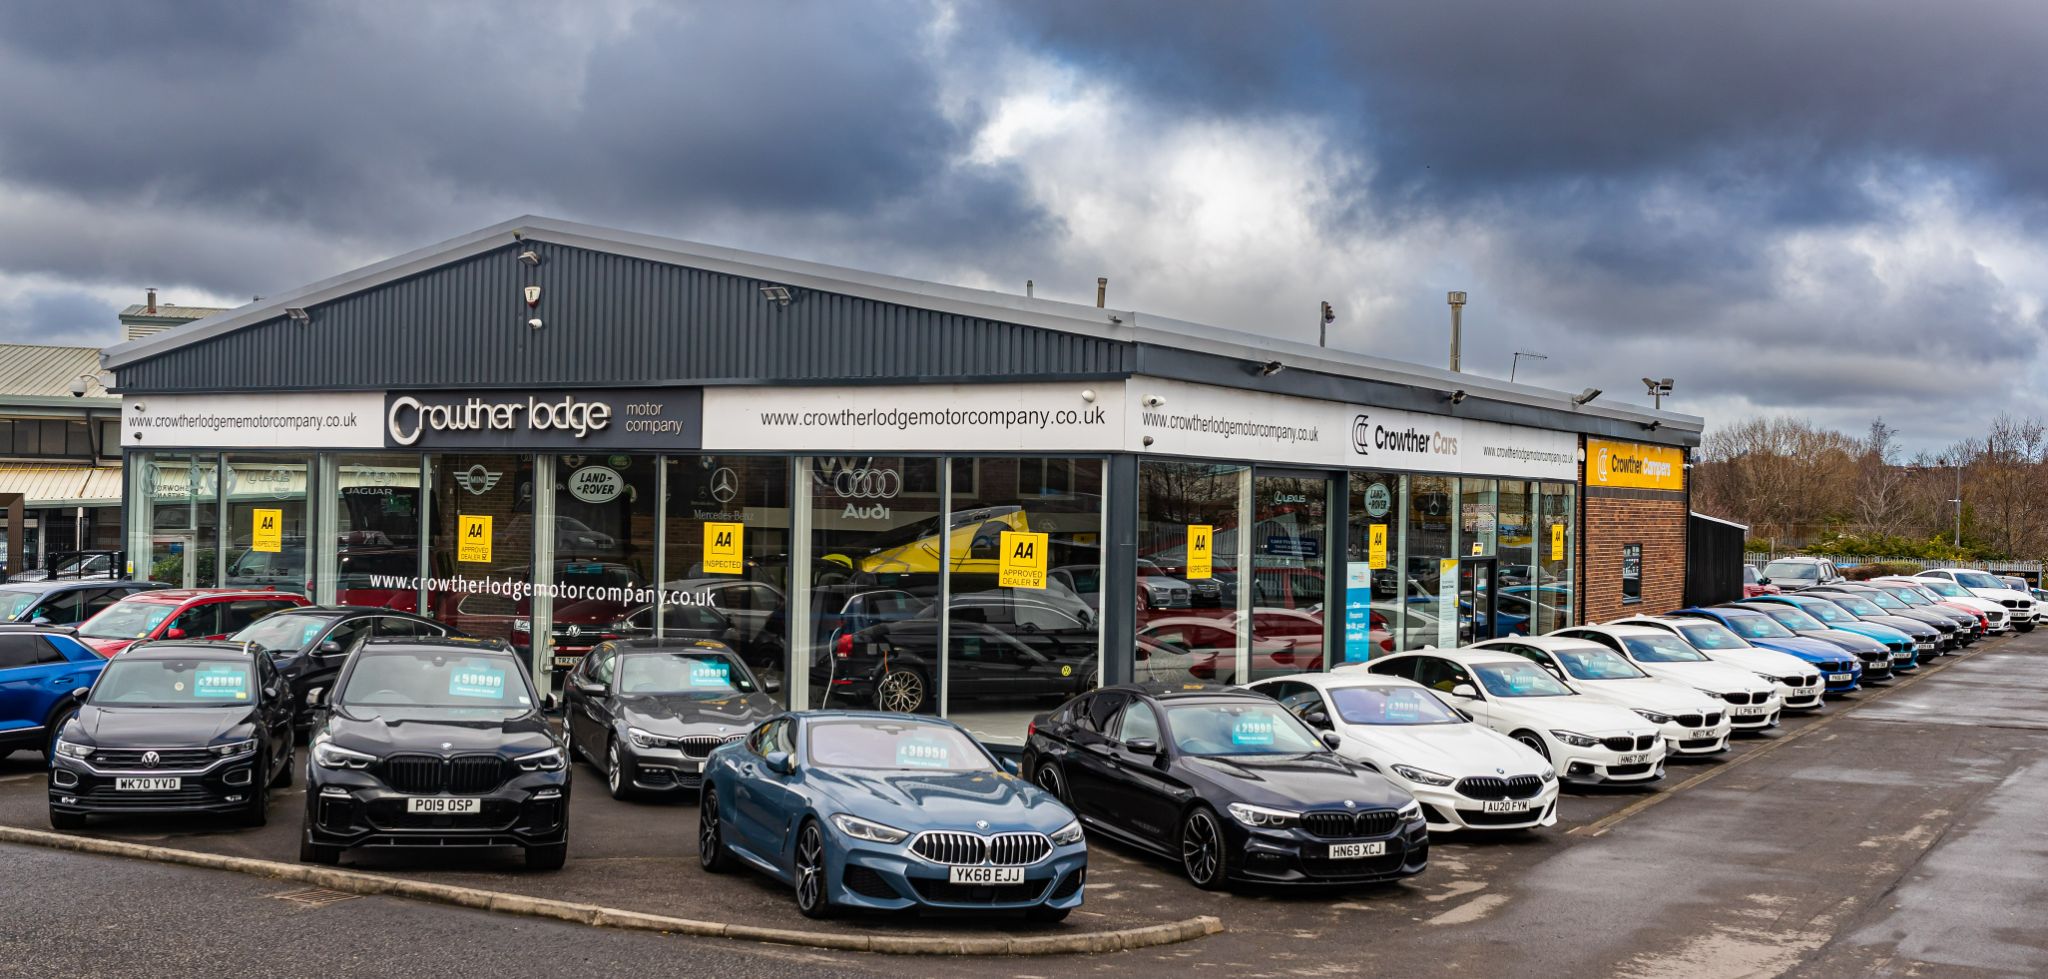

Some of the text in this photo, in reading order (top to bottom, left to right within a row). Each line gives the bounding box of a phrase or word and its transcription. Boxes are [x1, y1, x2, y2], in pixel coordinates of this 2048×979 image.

[626, 402, 664, 415] motor
[128, 412, 357, 431] www.crowtherlodgememotorcompany.co.uk
[389, 396, 611, 445] Crowther lodge
[761, 405, 1105, 430] www.crowtherlodgemotorcompany.co.uk
[626, 420, 683, 435] company
[1142, 411, 1318, 443] www.crowtherlodgemotorcompany.co.uk
[1375, 425, 1457, 455] Crowther Cars
[1612, 454, 1670, 482] Crowther Campers
[470, 475, 486, 484] MINI
[346, 487, 393, 495] JAGUAR
[1283, 494, 1306, 503] LEXUS
[841, 503, 890, 519] Audi
[261, 516, 273, 529] AA
[468, 523, 482, 538] AA
[714, 531, 732, 547] AA
[1195, 534, 1206, 551] AA
[1374, 532, 1383, 546] AA
[461, 553, 481, 561] DEALER
[462, 546, 489, 554] APPROVED
[1013, 542, 1034, 559] AA
[705, 559, 742, 569] INSPECTED
[1003, 569, 1043, 579] APPROVED
[1002, 577, 1032, 586] DEALER
[369, 574, 716, 607] www.crowtherlodgemotorcompany.co.uk
[121, 779, 176, 789] WK70 YVD
[416, 799, 473, 811] PO19 OSP
[1488, 801, 1528, 811] AU20 FYM
[1333, 843, 1382, 857] HN69 XCJ
[957, 868, 1020, 882] YK68 EJJ
